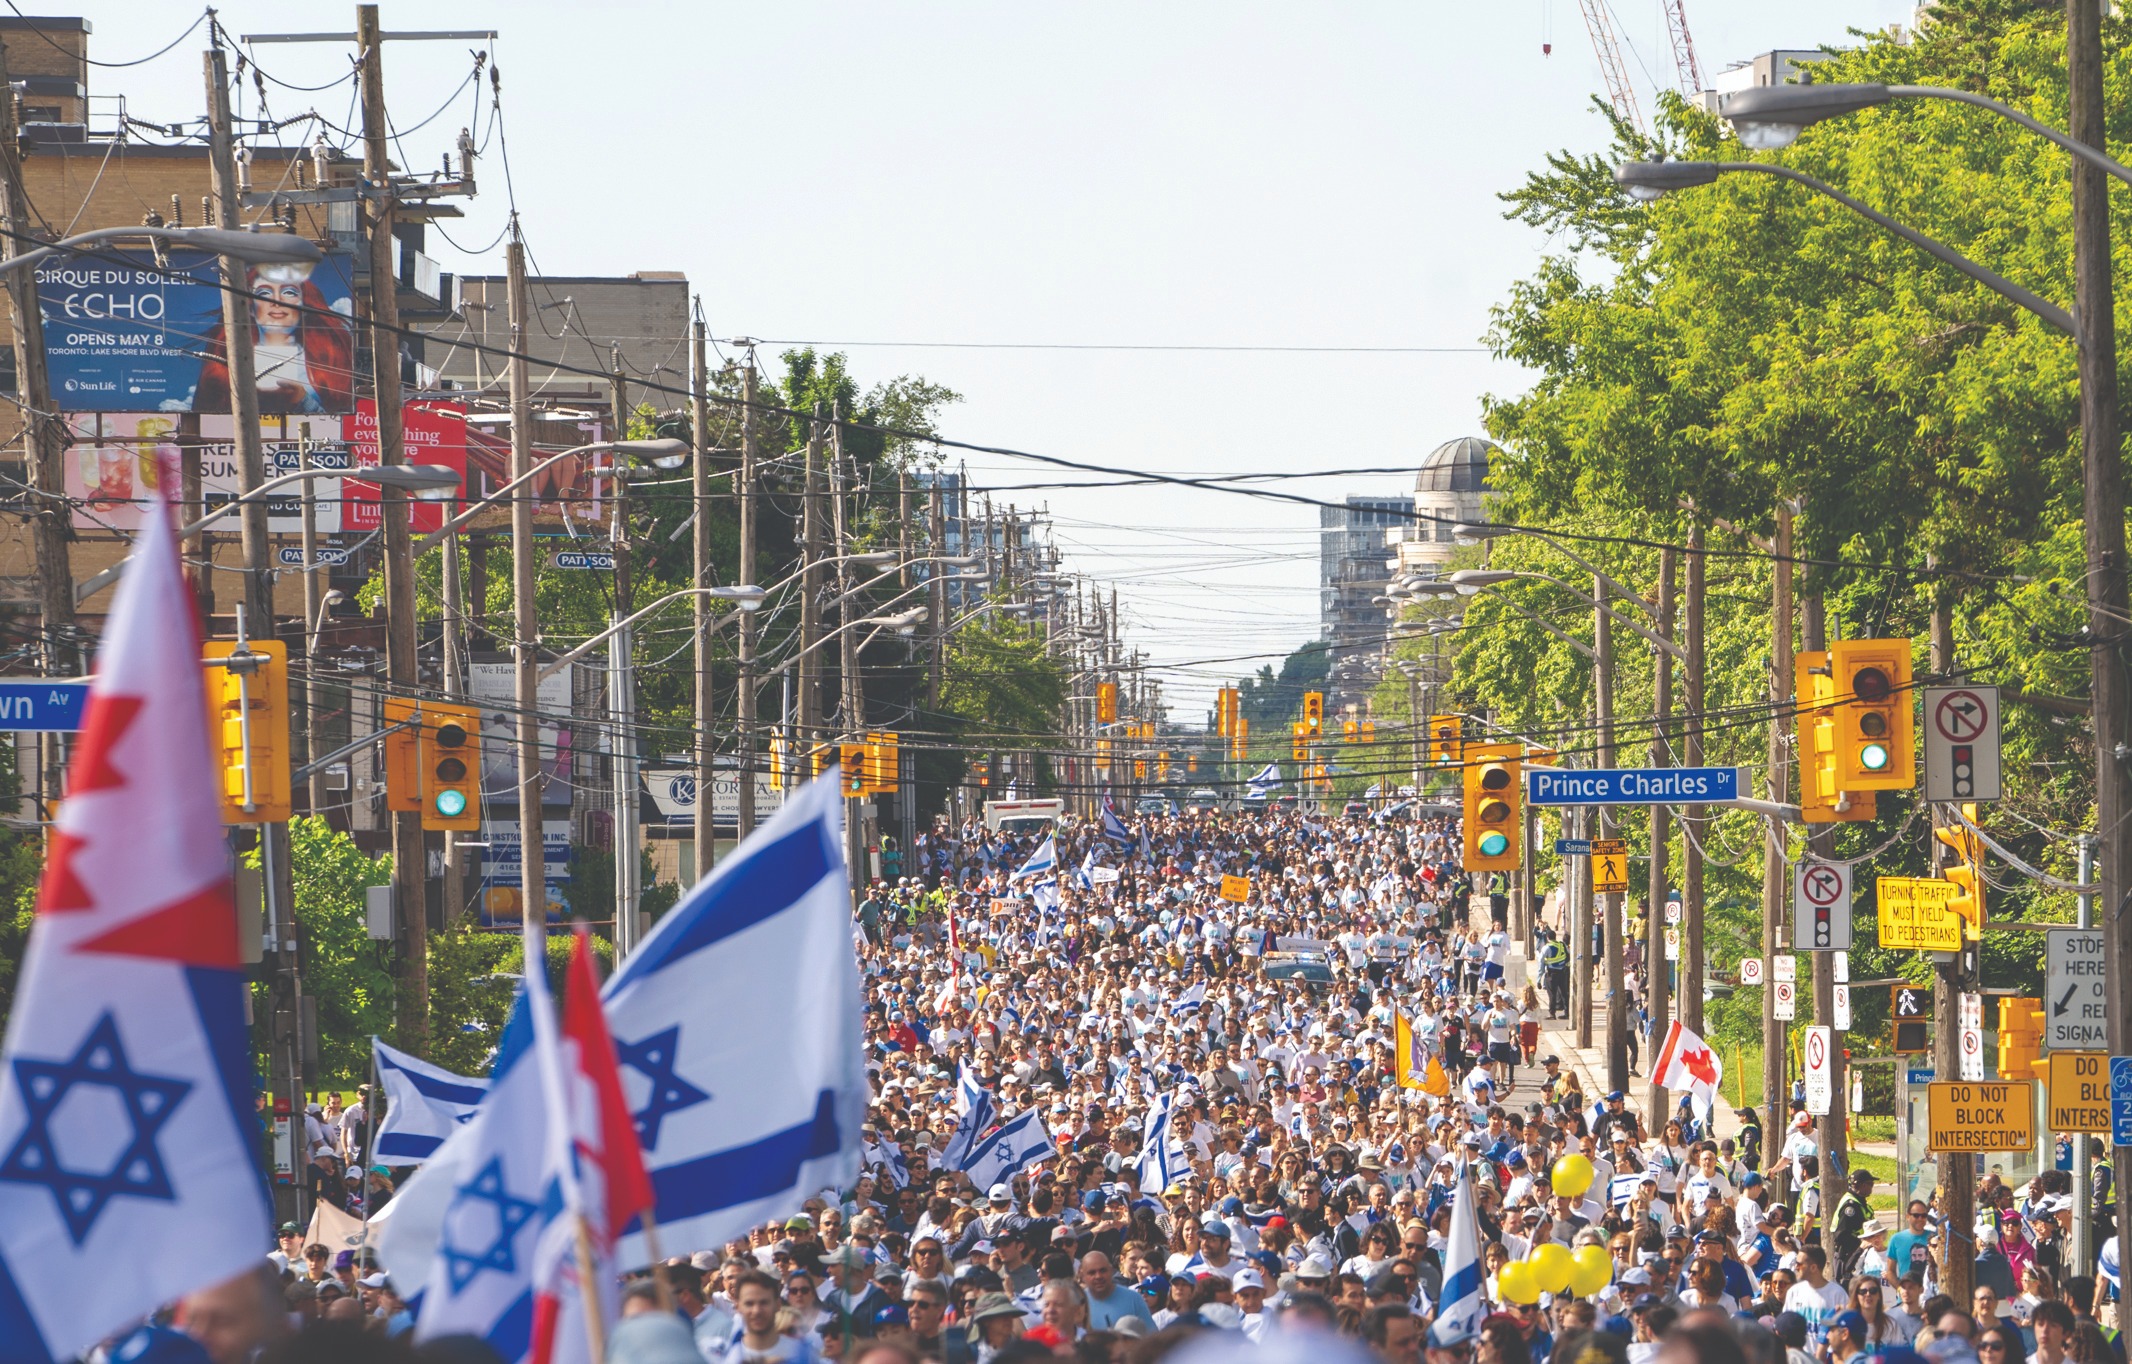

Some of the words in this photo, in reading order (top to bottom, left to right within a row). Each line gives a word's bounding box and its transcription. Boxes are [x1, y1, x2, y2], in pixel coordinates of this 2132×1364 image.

[34, 270, 100, 288] CIRQUE
[105, 271, 130, 284] DU
[135, 271, 196, 286] SOLEIL
[64, 293, 164, 319] ECHO
[66, 334, 116, 346] OPENS
[119, 335, 151, 346] MAY
[154, 334, 164, 346] 8
[140, 348, 160, 356] BLVD
[80, 382, 98, 391] Sun
[99, 381, 117, 391] Life
[354, 427, 440, 447] evehing
[279, 454, 348, 468] PAISON
[200, 461, 287, 479] SUMER
[285, 551, 345, 562] PATSO
[561, 555, 614, 566] PATTSO
[48, 690, 70, 706] Av
[1538, 774, 1609, 797] Prince
[1619, 773, 1708, 796] Charles
[1717, 772, 1731, 784] Dr
[482, 833, 550, 842] CONSTRUN
[551, 833, 568, 842] INC.
[1565, 842, 1590, 852] Sarana
[1881, 885, 1917, 900] TURNING
[1920, 886, 1954, 902] TRAFFIC
[1893, 906, 1915, 920] MUST
[1920, 906, 1945, 922] YIELD
[1883, 925, 1894, 940] TO
[1898, 925, 1956, 943] PEDESTRIANS
[2065, 960, 2106, 976] HERE
[2082, 1003, 2107, 1018] RE
[2056, 1025, 2107, 1041] SIGNA
[2075, 1058, 2098, 1076] DO
[1951, 1087, 1971, 1103] DO
[1981, 1087, 2008, 1103] NOT
[2081, 1083, 2111, 1101] BLO
[1956, 1108, 2005, 1125] BLOCK
[2055, 1107, 2111, 1127] INTERS
[1935, 1130, 2027, 1147] INTERSECTION
